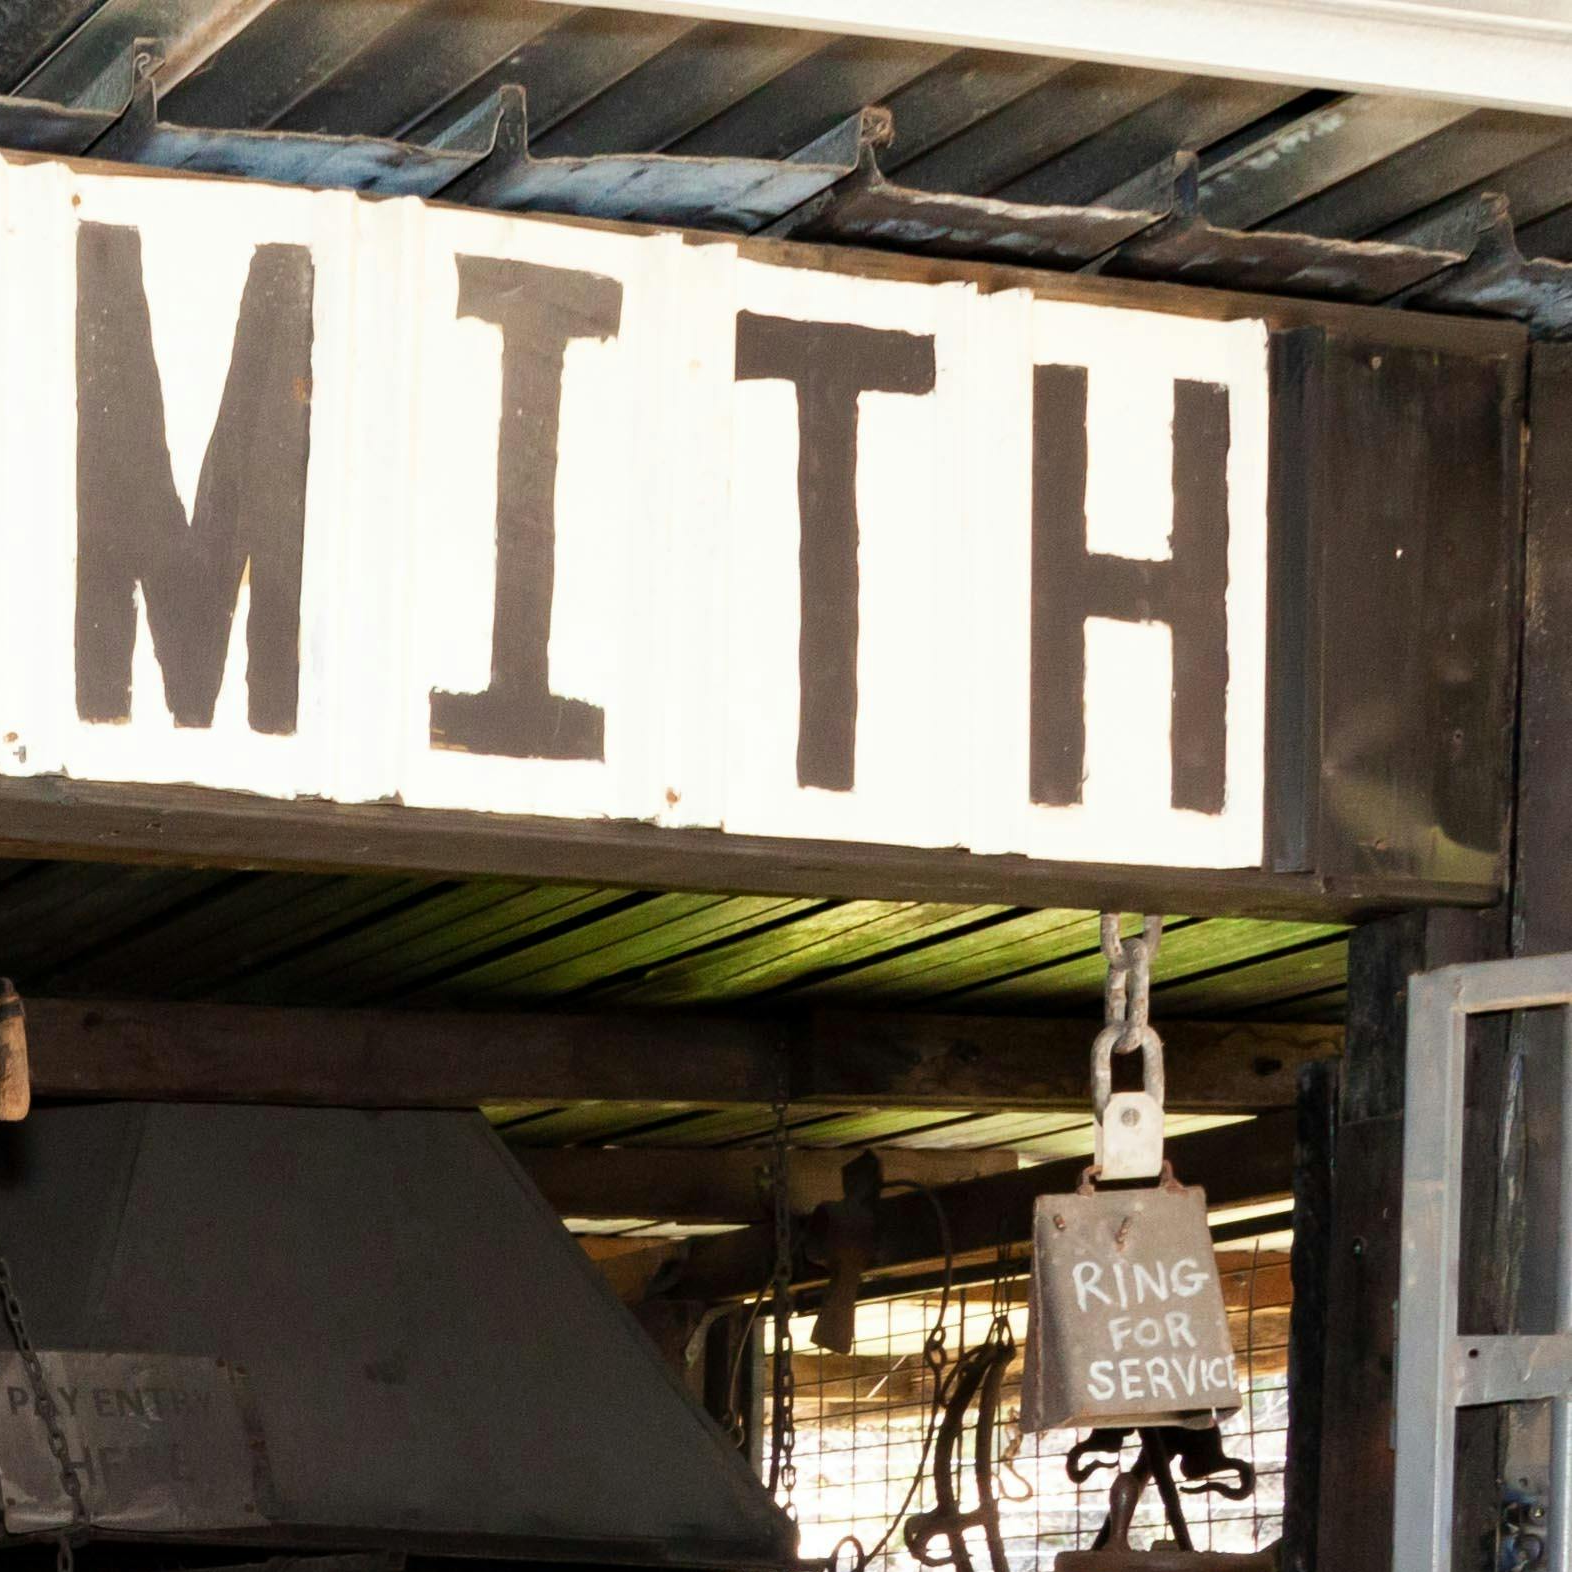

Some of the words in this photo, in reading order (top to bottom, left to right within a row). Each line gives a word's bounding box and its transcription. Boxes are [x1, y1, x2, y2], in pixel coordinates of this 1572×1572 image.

[1071, 1257, 1209, 1312] RING
[1108, 1310, 1197, 1352] FOR
[1087, 1353, 1237, 1401] SERVICE
